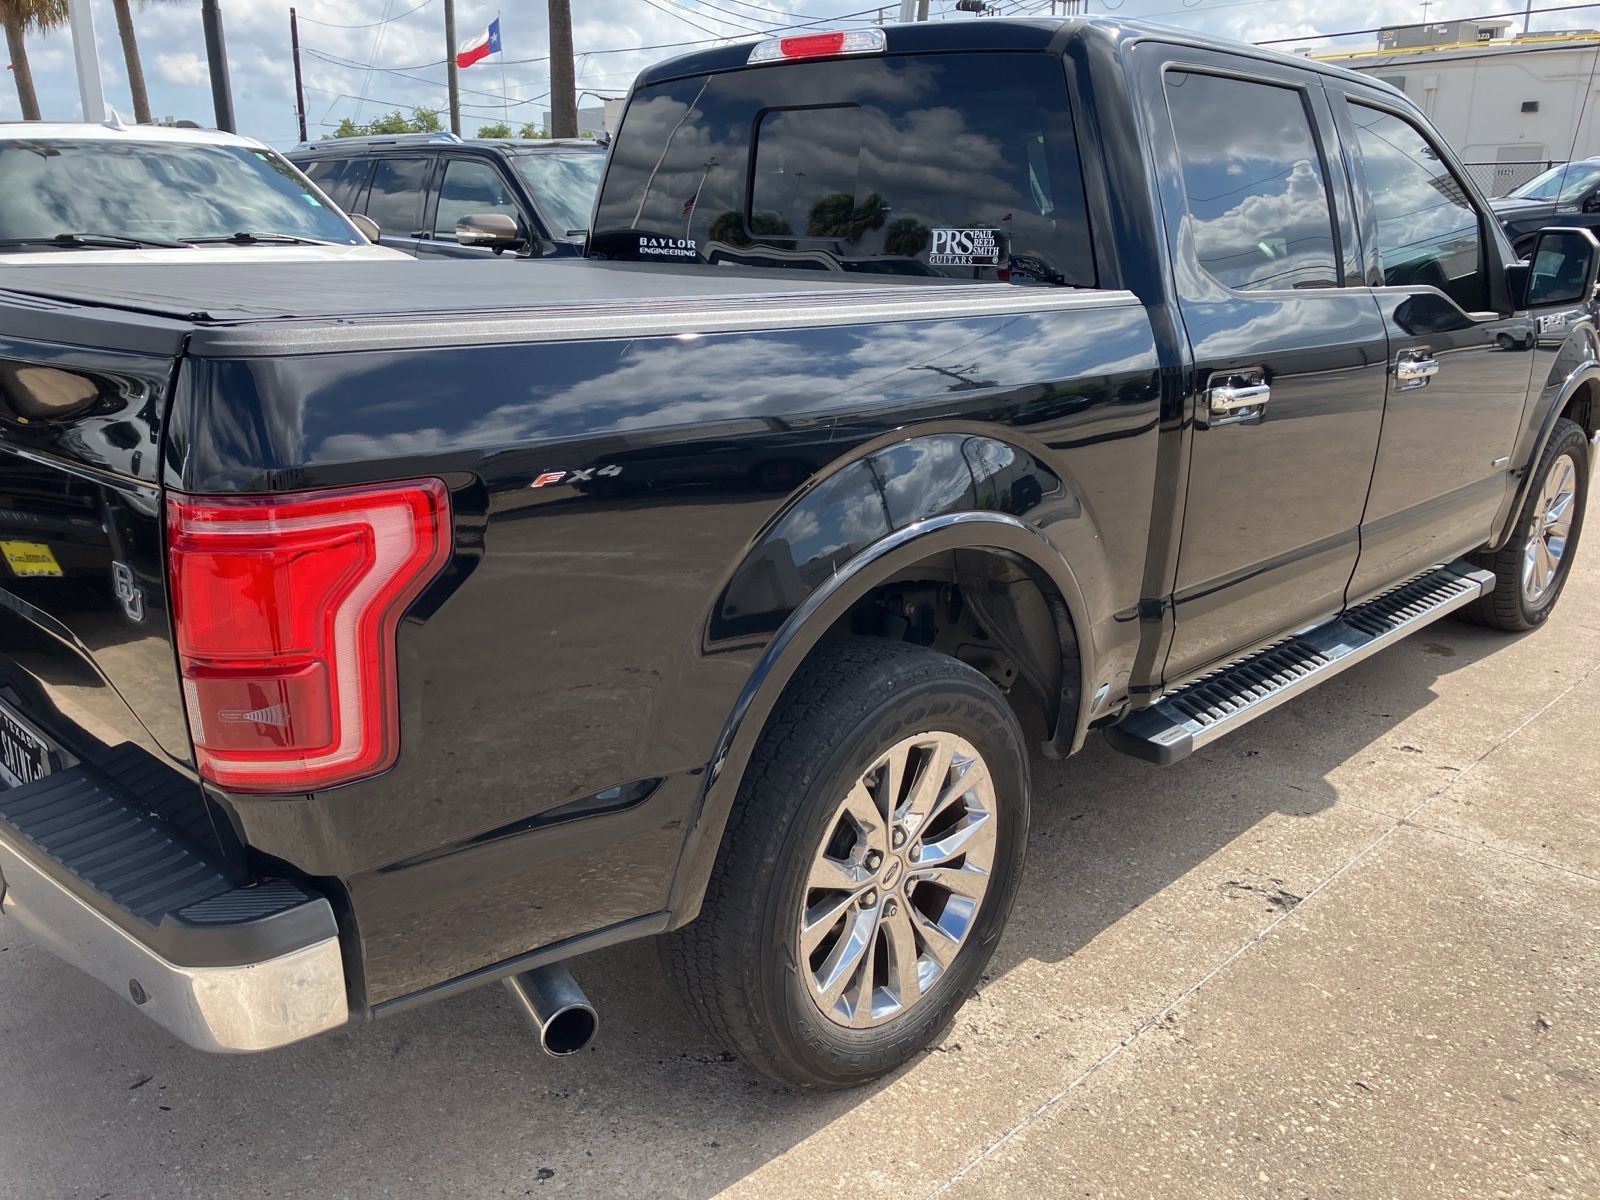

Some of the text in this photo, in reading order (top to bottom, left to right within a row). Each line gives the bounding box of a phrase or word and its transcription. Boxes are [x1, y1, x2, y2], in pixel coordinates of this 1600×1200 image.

[974, 230, 995, 239] PAUL
[640, 237, 696, 249] BAYLOR
[930, 230, 974, 254] PRS
[974, 238, 995, 247] REED
[640, 246, 696, 257] ENGINEERING
[973, 246, 1000, 256] SMITH
[929, 255, 973, 264] GUITARS
[530, 464, 623, 488] FX4
[3, 715, 33, 749] TEXAS
